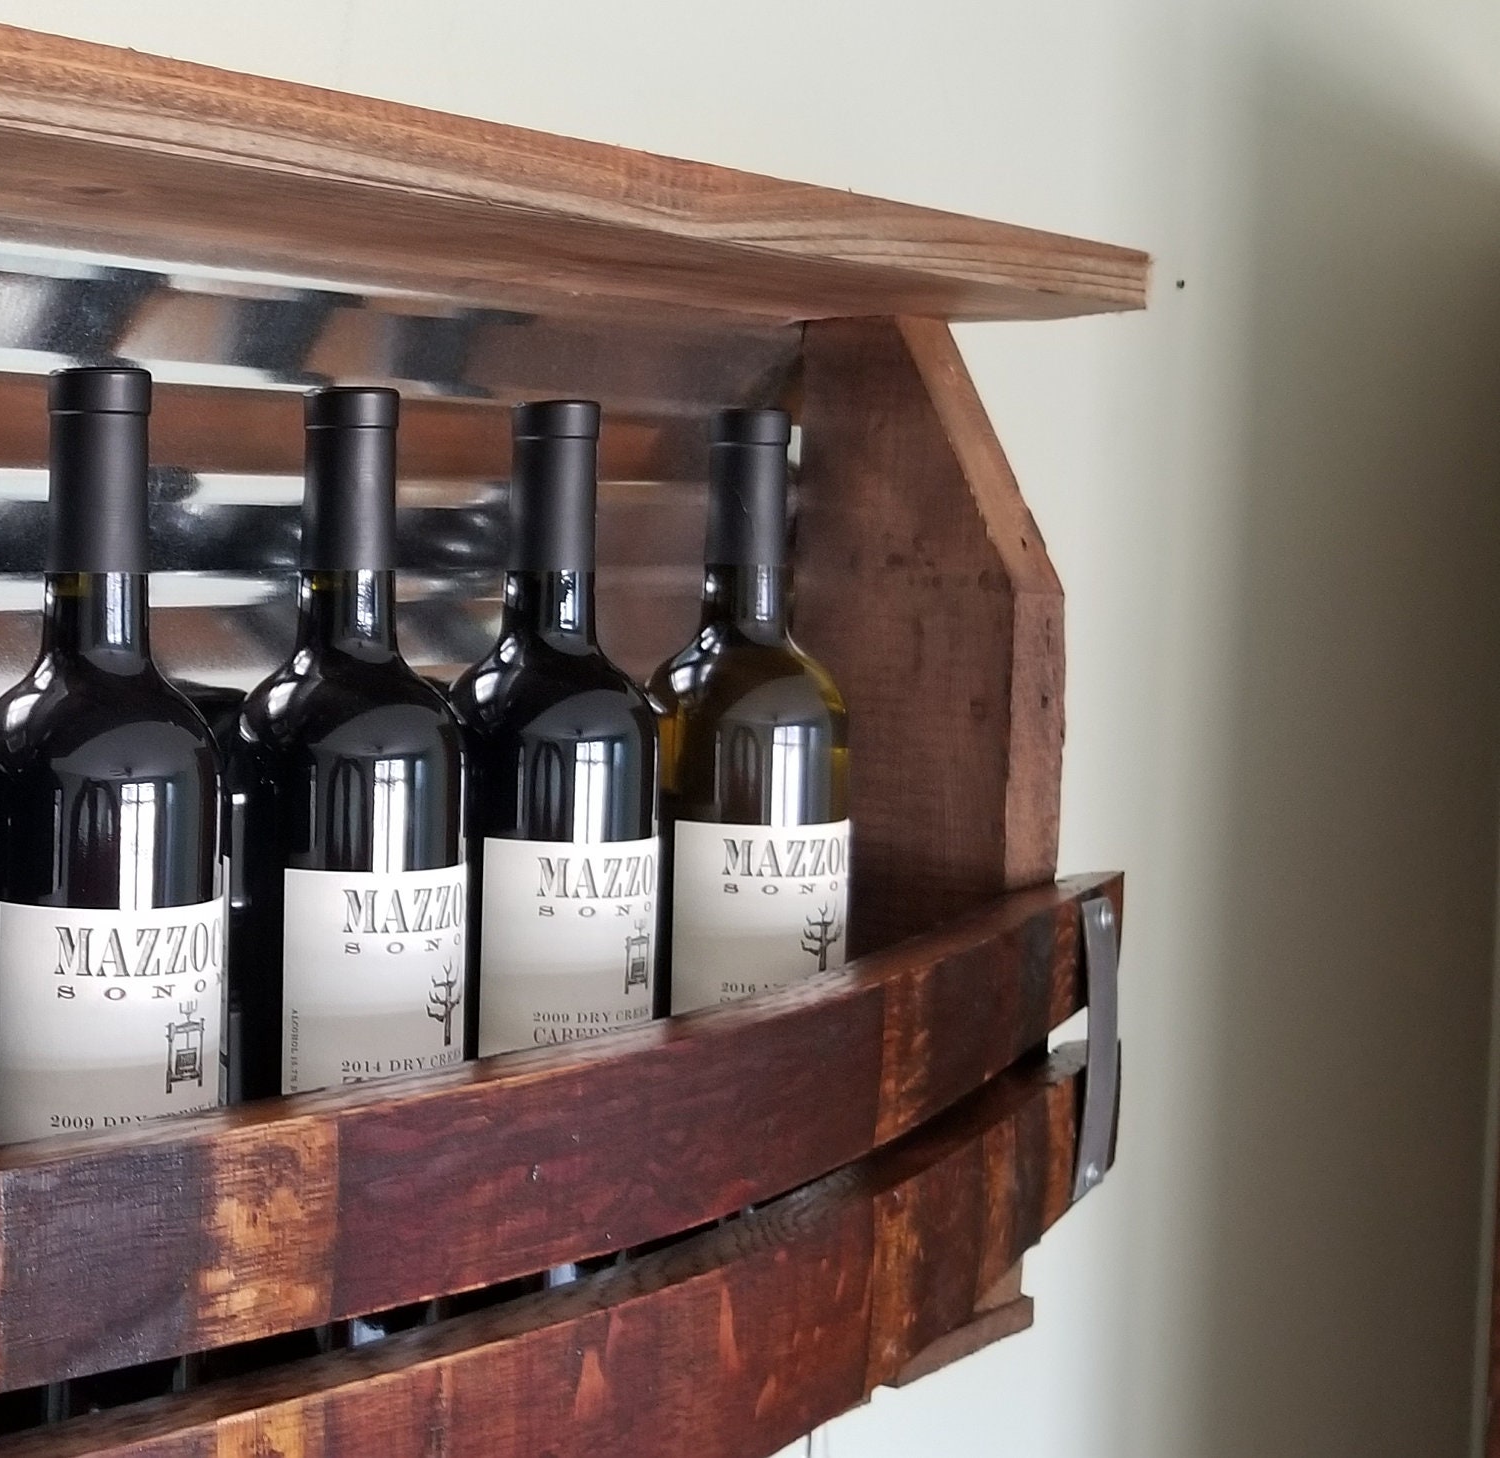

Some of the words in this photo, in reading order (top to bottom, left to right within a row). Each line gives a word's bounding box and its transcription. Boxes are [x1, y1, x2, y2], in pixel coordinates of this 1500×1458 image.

[342, 882, 464, 934] MAZZO
[344, 932, 462, 955] SONO
[577, 1011, 611, 1025] DRY
[291, 1008, 300, 1054] ALCOHOL
[341, 1059, 382, 1073] 2014
[389, 1056, 426, 1074] DRY
[50, 1113, 95, 1129] 2009
